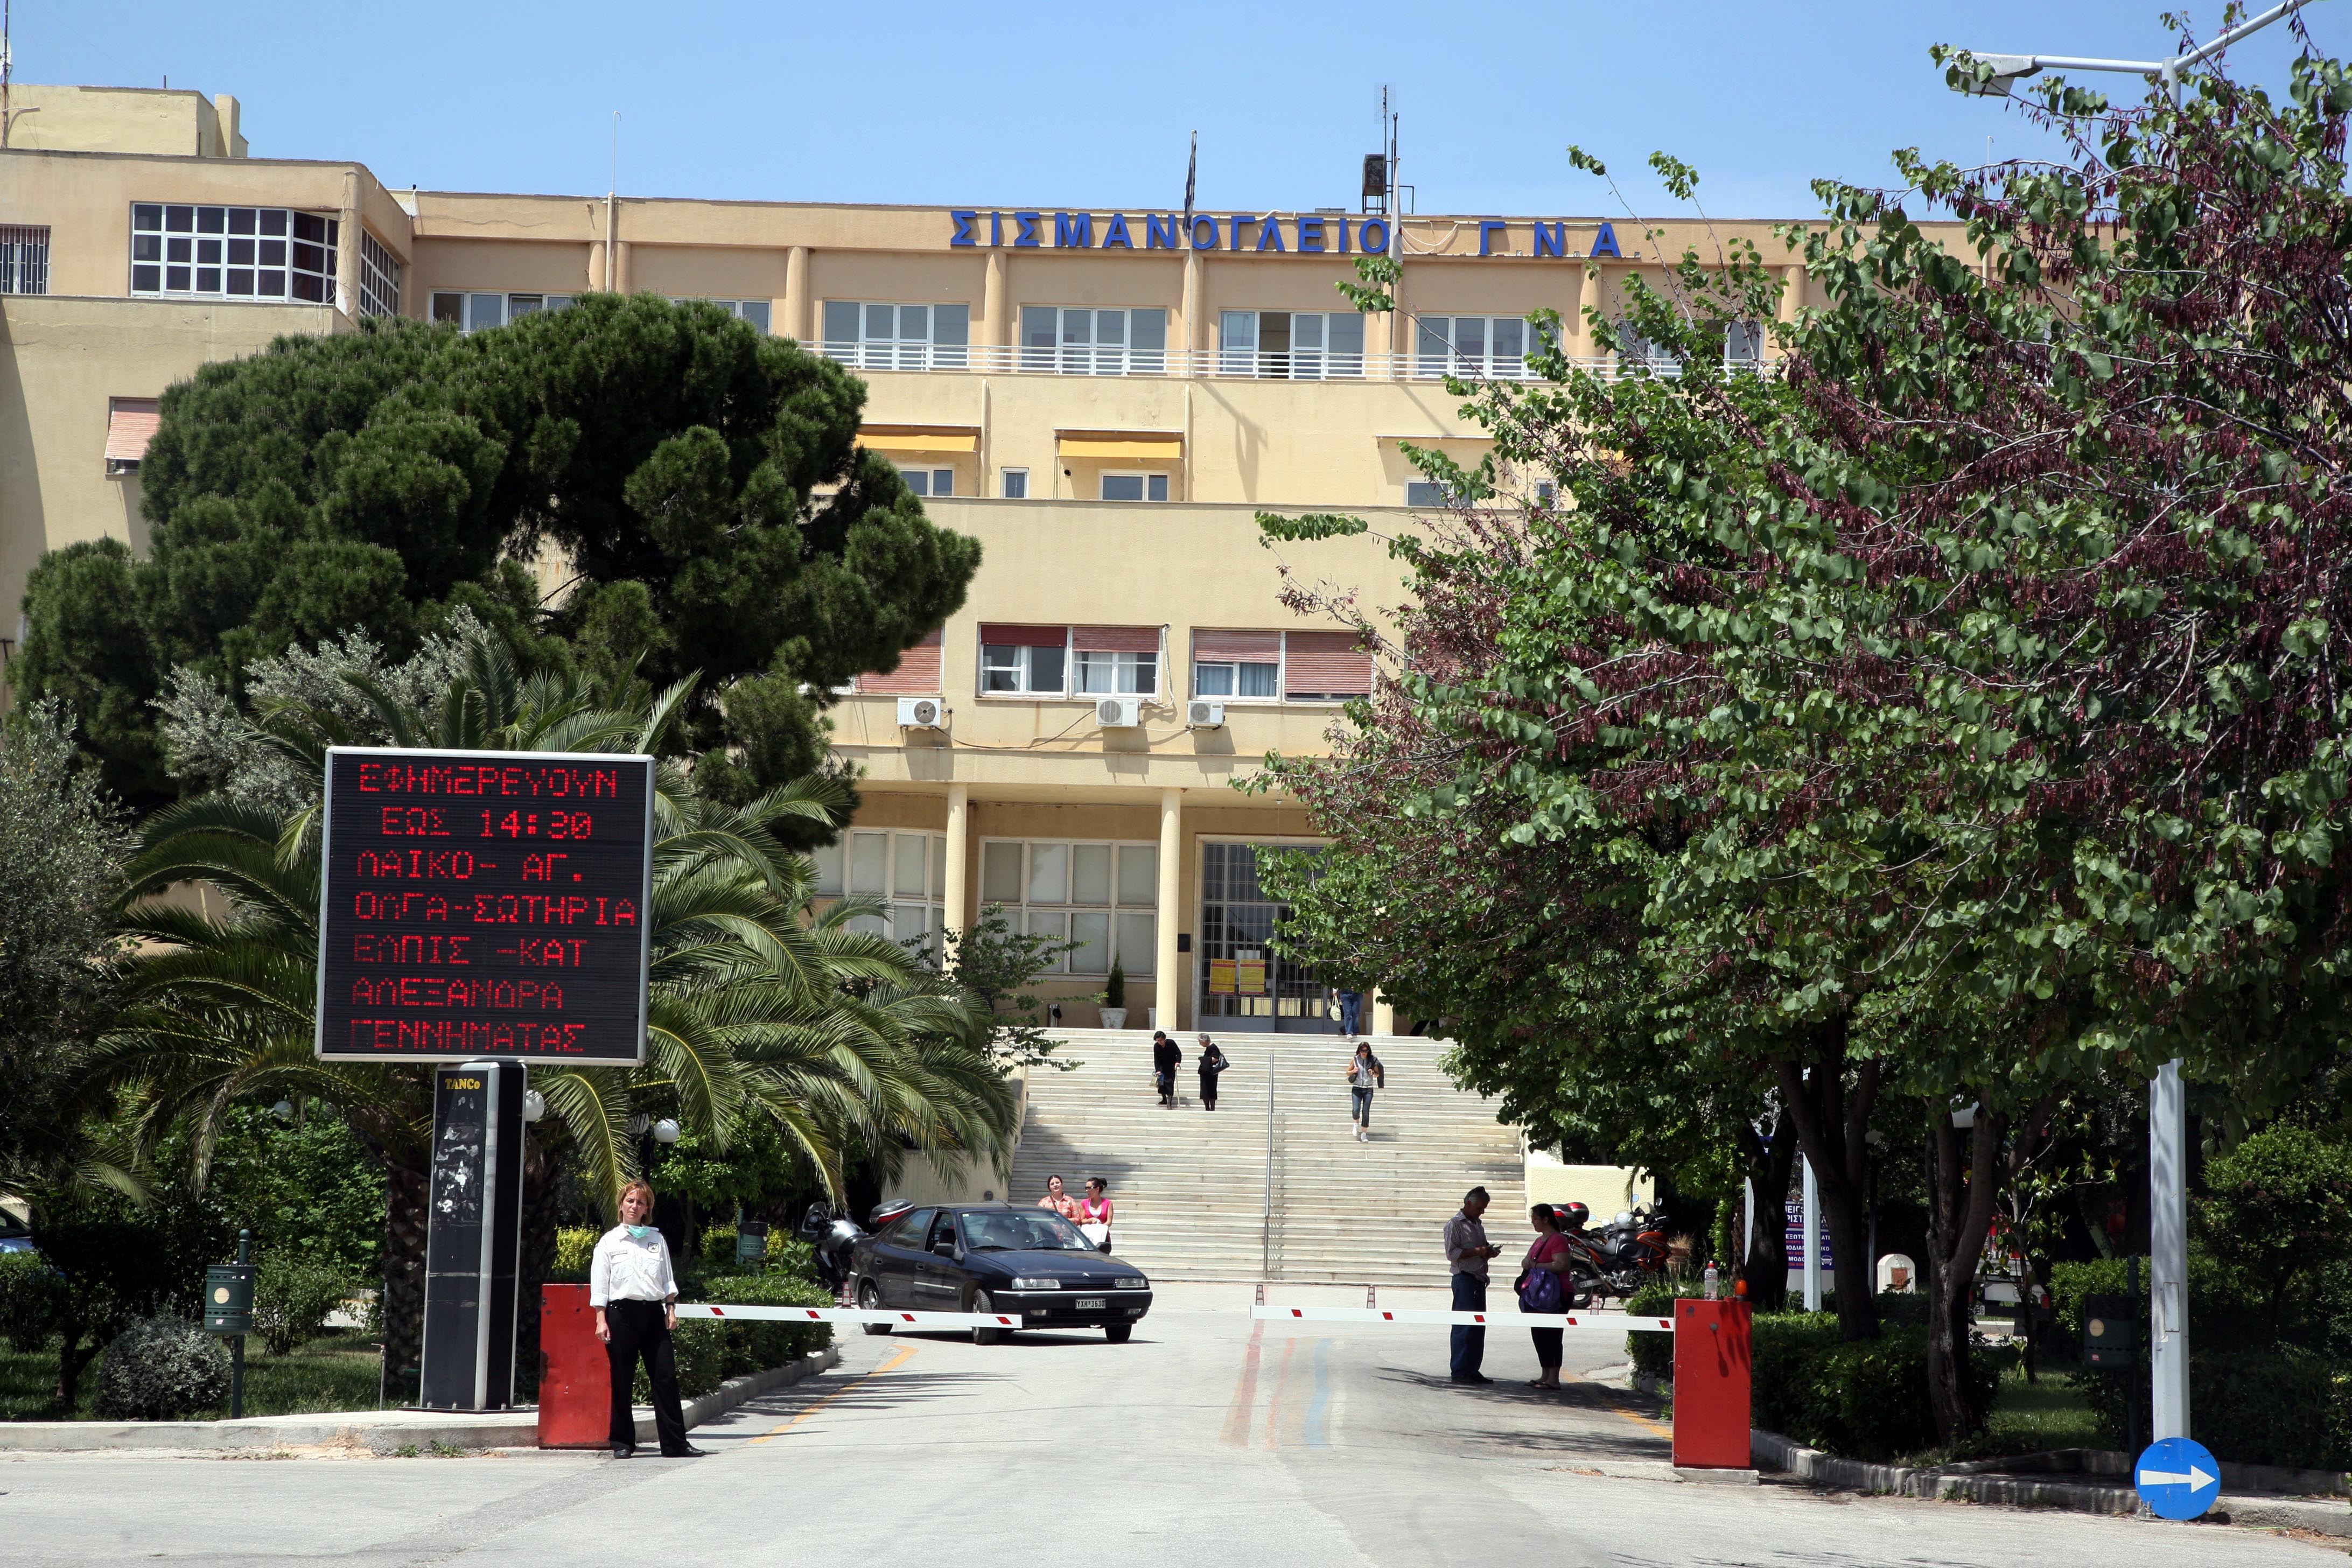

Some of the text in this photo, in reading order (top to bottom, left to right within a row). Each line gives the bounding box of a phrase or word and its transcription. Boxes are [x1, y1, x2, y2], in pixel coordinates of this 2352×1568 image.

[950, 210, 1390, 254] ΣΙΣΜΑΝΟΓΛΕΙΟ
[359, 763, 617, 797] ΕΦΗΜΕΡΕΥΟΥΝ
[381, 807, 592, 839] ΕΩΣ 14:30
[522, 853, 583, 882] ΑΓ.
[353, 934, 471, 964] ΕΛΠΙΣ
[352, 977, 563, 1009] ΑΛΕΞΑΝΔΡΑ
[350, 1019, 586, 1052] ΓΕΝΝΗΜΑΤΑΣ
